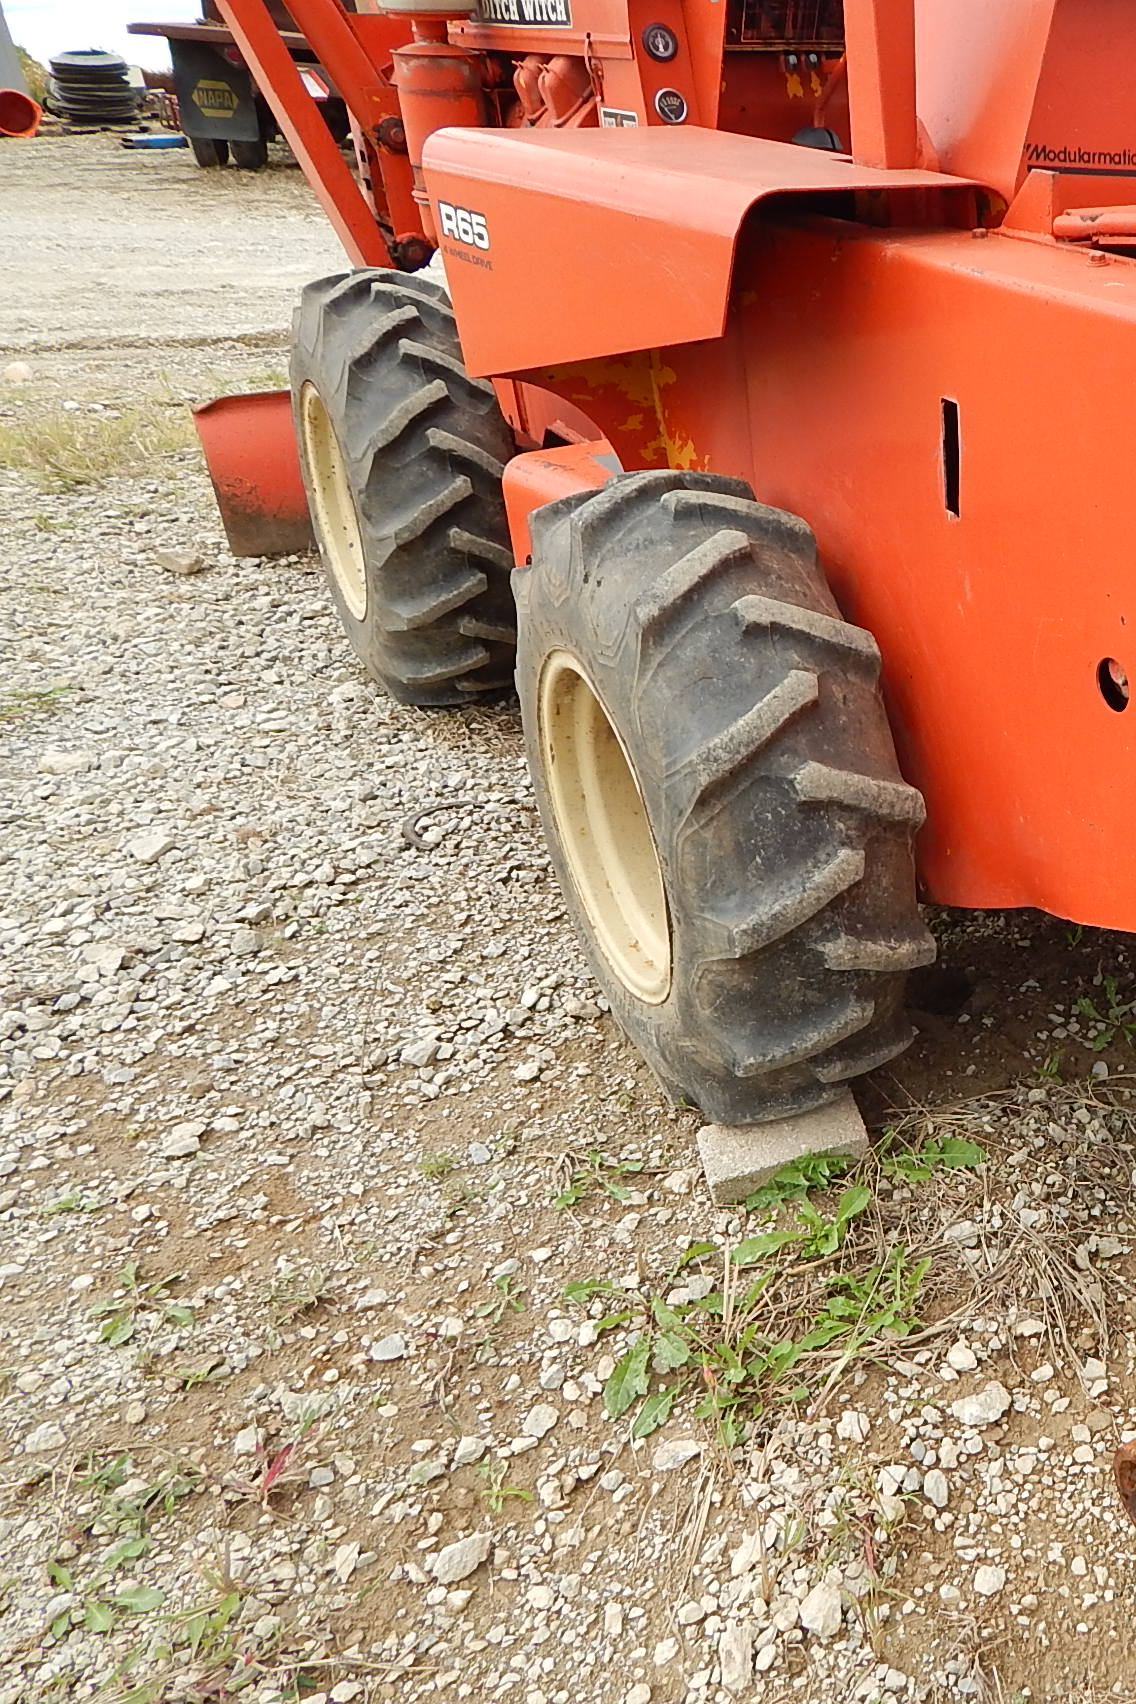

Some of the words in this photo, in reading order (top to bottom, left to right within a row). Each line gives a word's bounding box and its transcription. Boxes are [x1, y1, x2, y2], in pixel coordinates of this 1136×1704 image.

[481, 0, 520, 20] DITCH
[521, 0, 567, 21] WITCH
[198, 89, 233, 107] NAPA
[438, 200, 490, 251] R65
